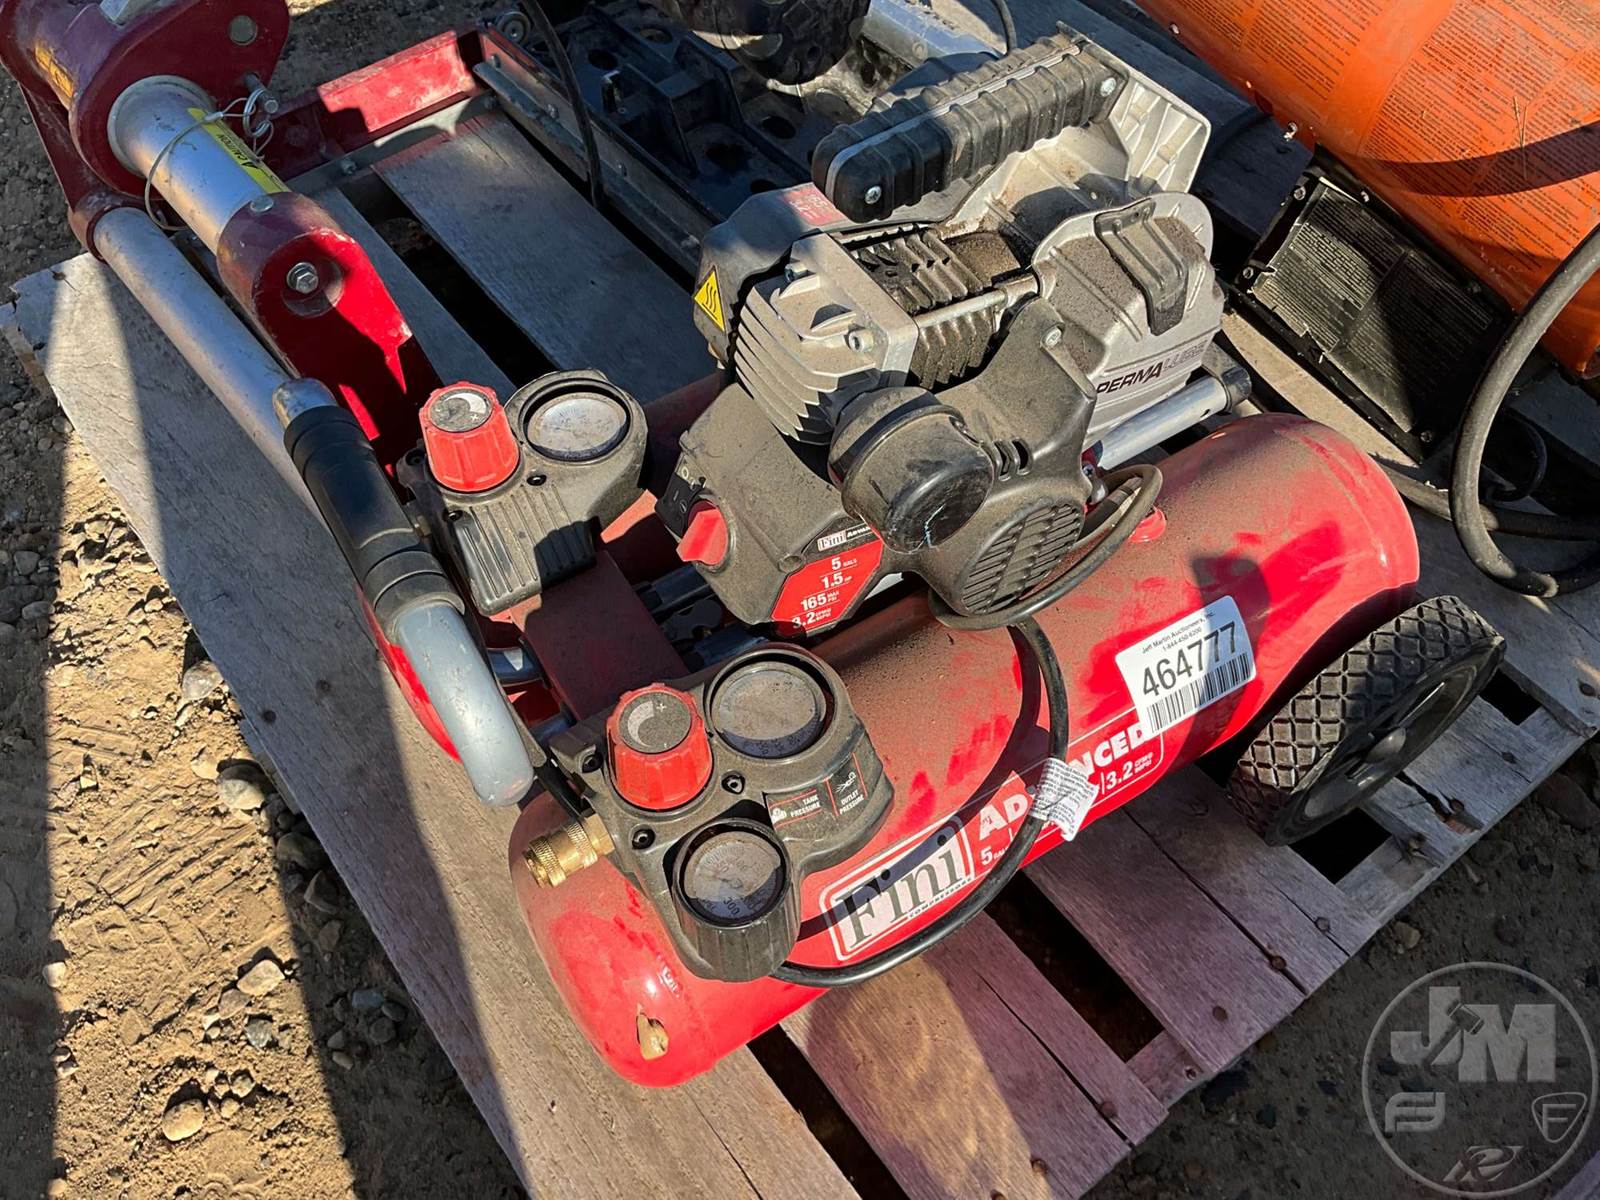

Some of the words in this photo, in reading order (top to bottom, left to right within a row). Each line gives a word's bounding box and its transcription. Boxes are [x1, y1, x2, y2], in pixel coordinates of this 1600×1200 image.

[820, 534, 845, 549] Fini
[831, 557, 841, 570] 5
[821, 572, 843, 589] 1.5
[800, 593, 827, 611] 165
[791, 611, 816, 629] 3.2
[1153, 632, 1171, 648] Martin
[1171, 617, 1207, 639] Auctioneers,
[1143, 621, 1236, 696] 464777
[1106, 760, 1134, 791] 3.2
[802, 794, 819, 806] TANK
[840, 794, 865, 815] PRESSURE
[841, 789, 859, 806] OUTLET
[790, 801, 821, 817] PRESSURE
[980, 846, 994, 865] 5
[834, 835, 965, 949] Fini
